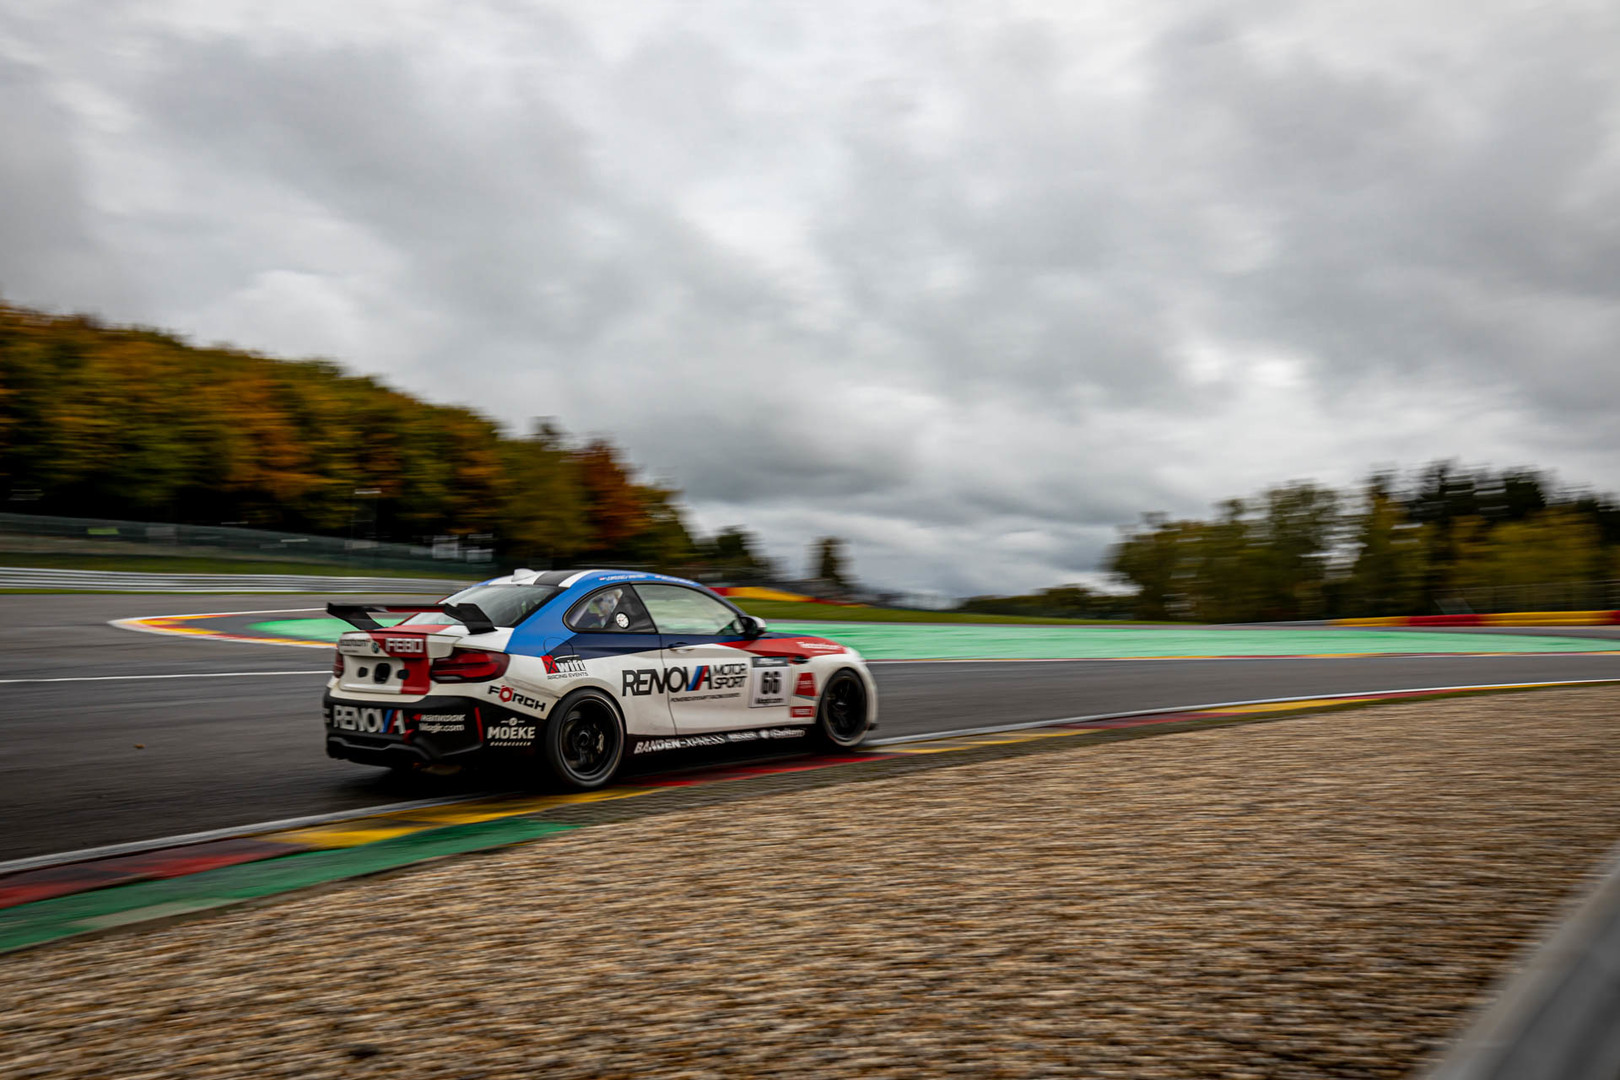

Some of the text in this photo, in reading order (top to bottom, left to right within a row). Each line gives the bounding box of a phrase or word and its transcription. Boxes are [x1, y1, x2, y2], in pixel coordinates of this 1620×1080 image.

[622, 665, 712, 697] RENOVA
[761, 671, 782, 695] 66
[333, 704, 406, 735] RENOVA
[487, 726, 536, 740] MOEKE
